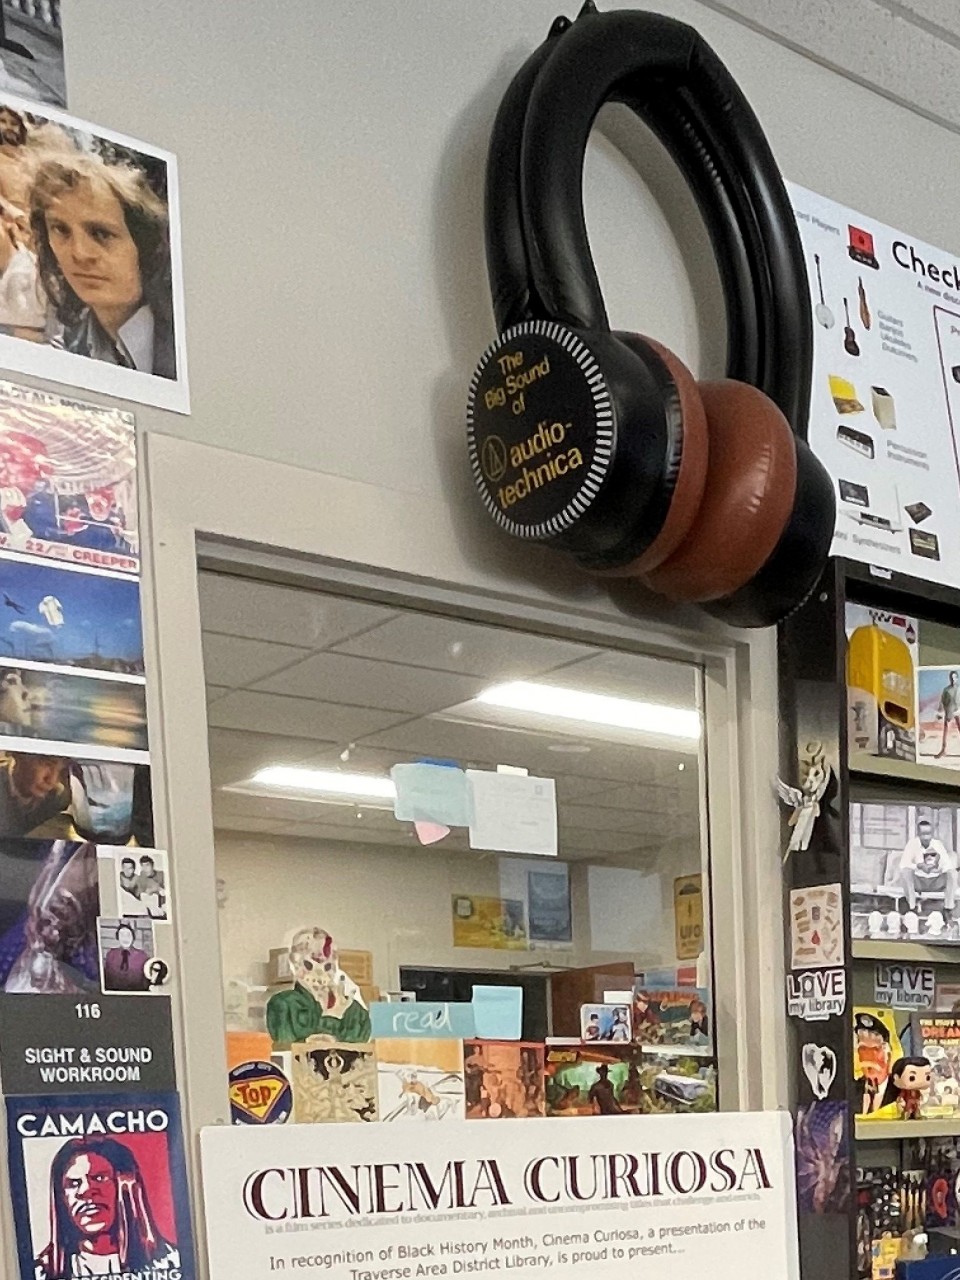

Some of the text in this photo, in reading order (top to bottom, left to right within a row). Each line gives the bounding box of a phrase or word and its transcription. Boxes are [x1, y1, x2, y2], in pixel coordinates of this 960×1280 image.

[498, 351, 523, 374] The
[484, 355, 550, 409] Big Sound
[511, 393, 526, 415] of
[510, 420, 572, 468] audio-
[499, 447, 583, 509] technica
[73, 549, 137, 568] CREEPER
[680, 926, 701, 939] UFO
[788, 971, 843, 998] LOVE
[876, 966, 933, 990] LOVE
[789, 999, 844, 1019] my library
[877, 991, 894, 1007] my
[896, 988, 933, 1007] library
[75, 1003, 101, 1019] 116
[392, 1002, 453, 1033] read
[25, 1048, 152, 1064] SIGHT & SOUND
[40, 1066, 140, 1083] WORKROOM
[17, 1109, 169, 1137] CAMACHO
[242, 1148, 774, 1221] CINEMA CURIOSA
[270, 1217, 766, 1271] In recognition of Black History Month, Cinema Curiosa, a presentation of the
[415, 1262, 448, 1277] Area
[453, 1257, 501, 1274] District
[505, 1252, 553, 1269] Library,
[557, 1251, 568, 1264] is
[572, 1248, 608, 1265] proud
[612, 1247, 625, 1260] to
